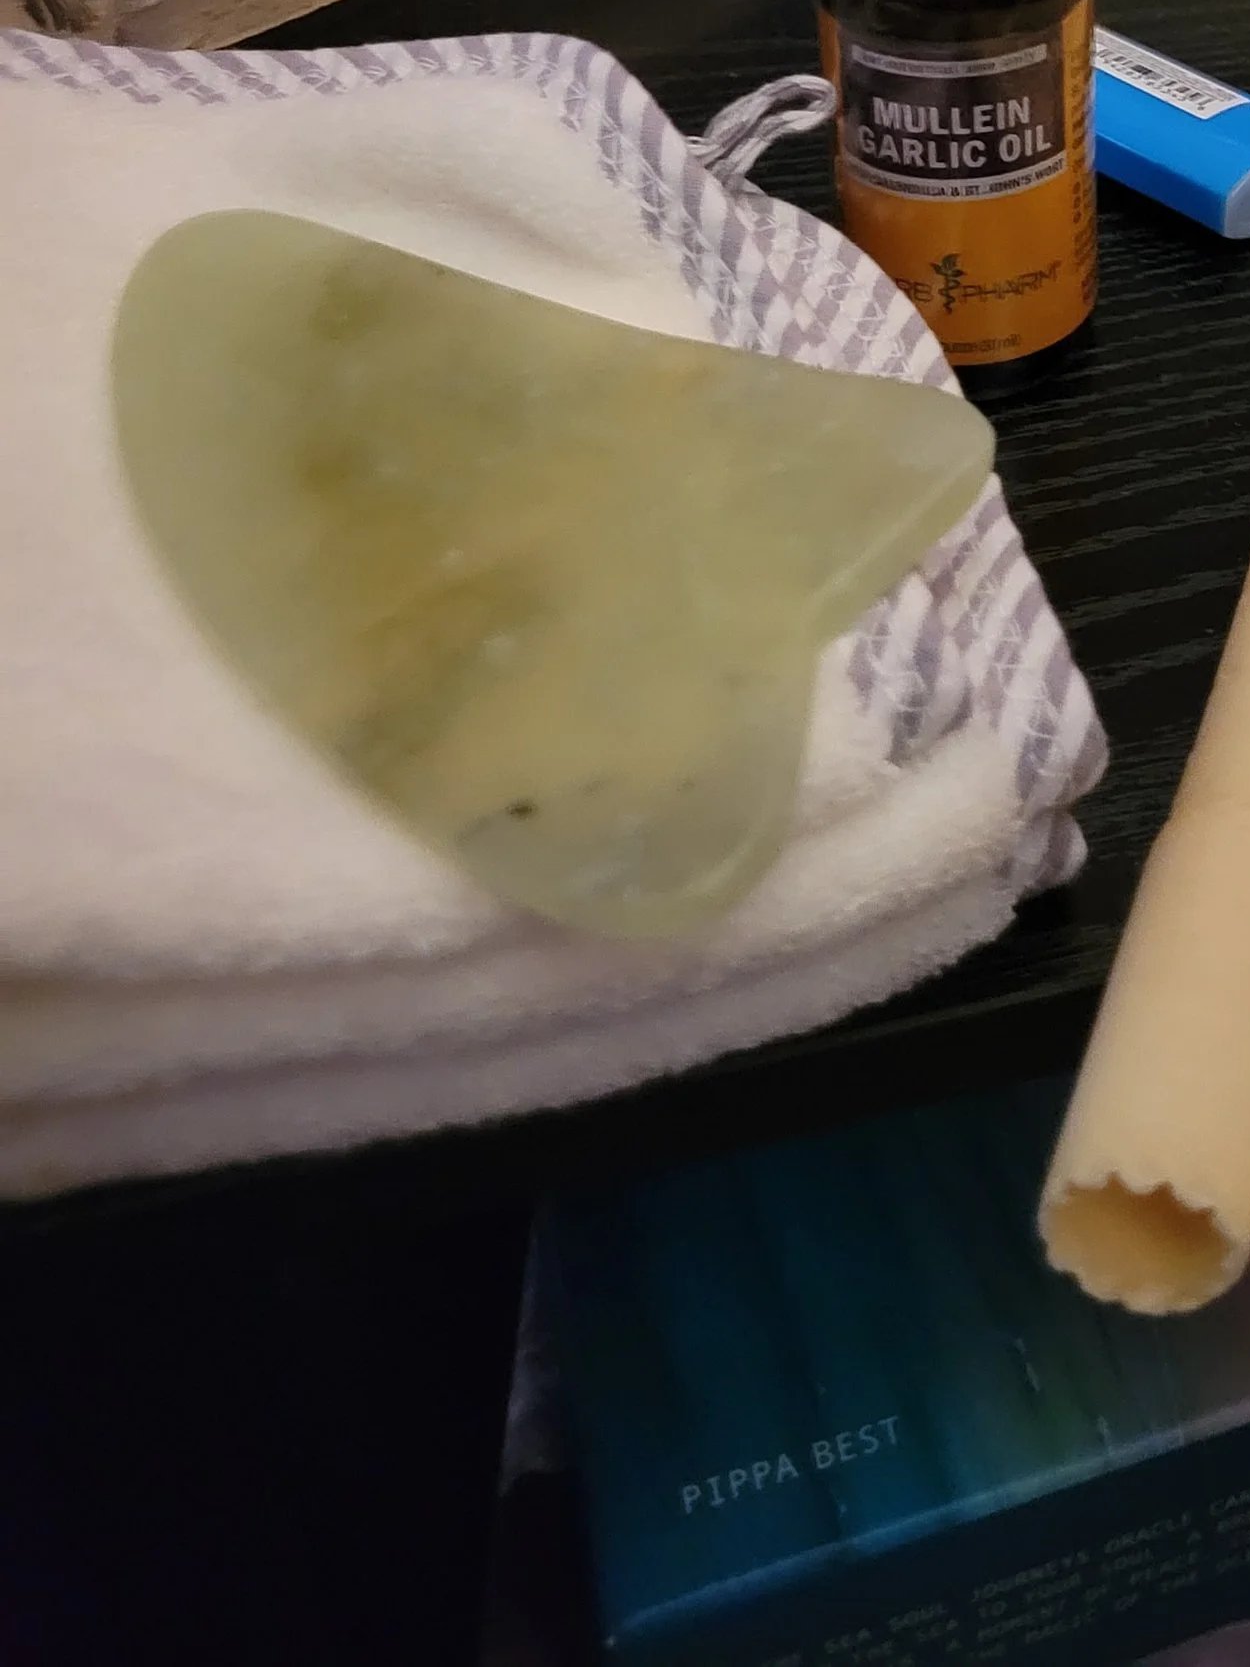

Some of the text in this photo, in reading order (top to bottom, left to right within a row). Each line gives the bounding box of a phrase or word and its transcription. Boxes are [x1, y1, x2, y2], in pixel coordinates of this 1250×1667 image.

[857, 125, 1052, 169] GARLIC OIL
[872, 96, 1030, 135] MULLEIN
[680, 1415, 899, 1514] PIPPA BEST
[824, 1627, 871, 1654] SEA
[887, 1602, 948, 1633] SOUL
[971, 1548, 1090, 1603] JOURNEYS
[1104, 1508, 1192, 1554] ORACLE
